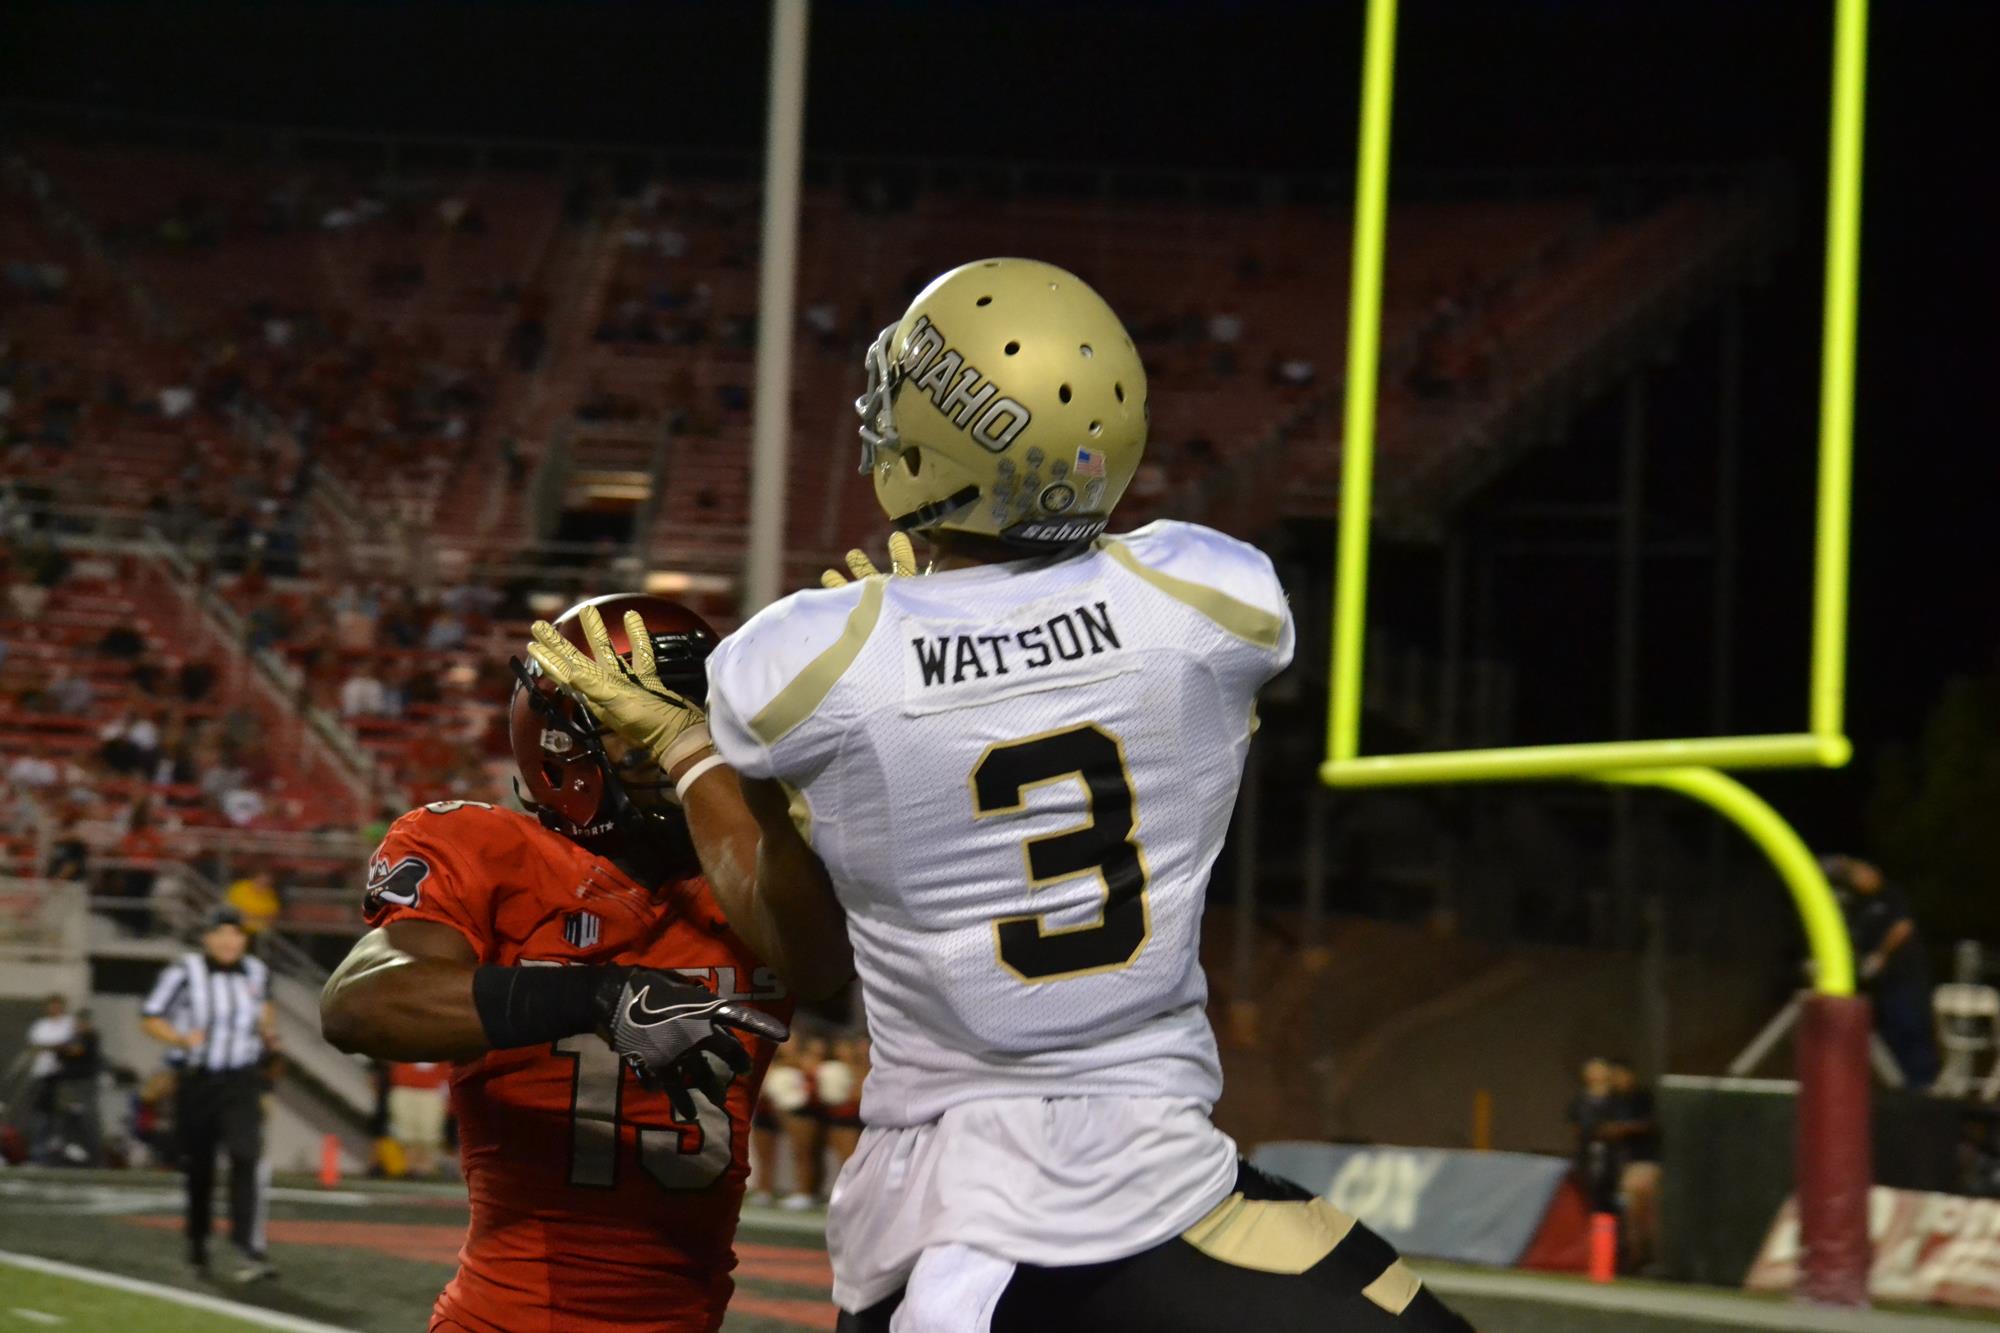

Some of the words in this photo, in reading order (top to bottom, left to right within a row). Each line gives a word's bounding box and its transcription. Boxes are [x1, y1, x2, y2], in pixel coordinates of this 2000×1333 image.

[901, 314, 1031, 453] IDAHO
[912, 602, 1122, 687] WATSON
[967, 720, 1152, 985] 3
